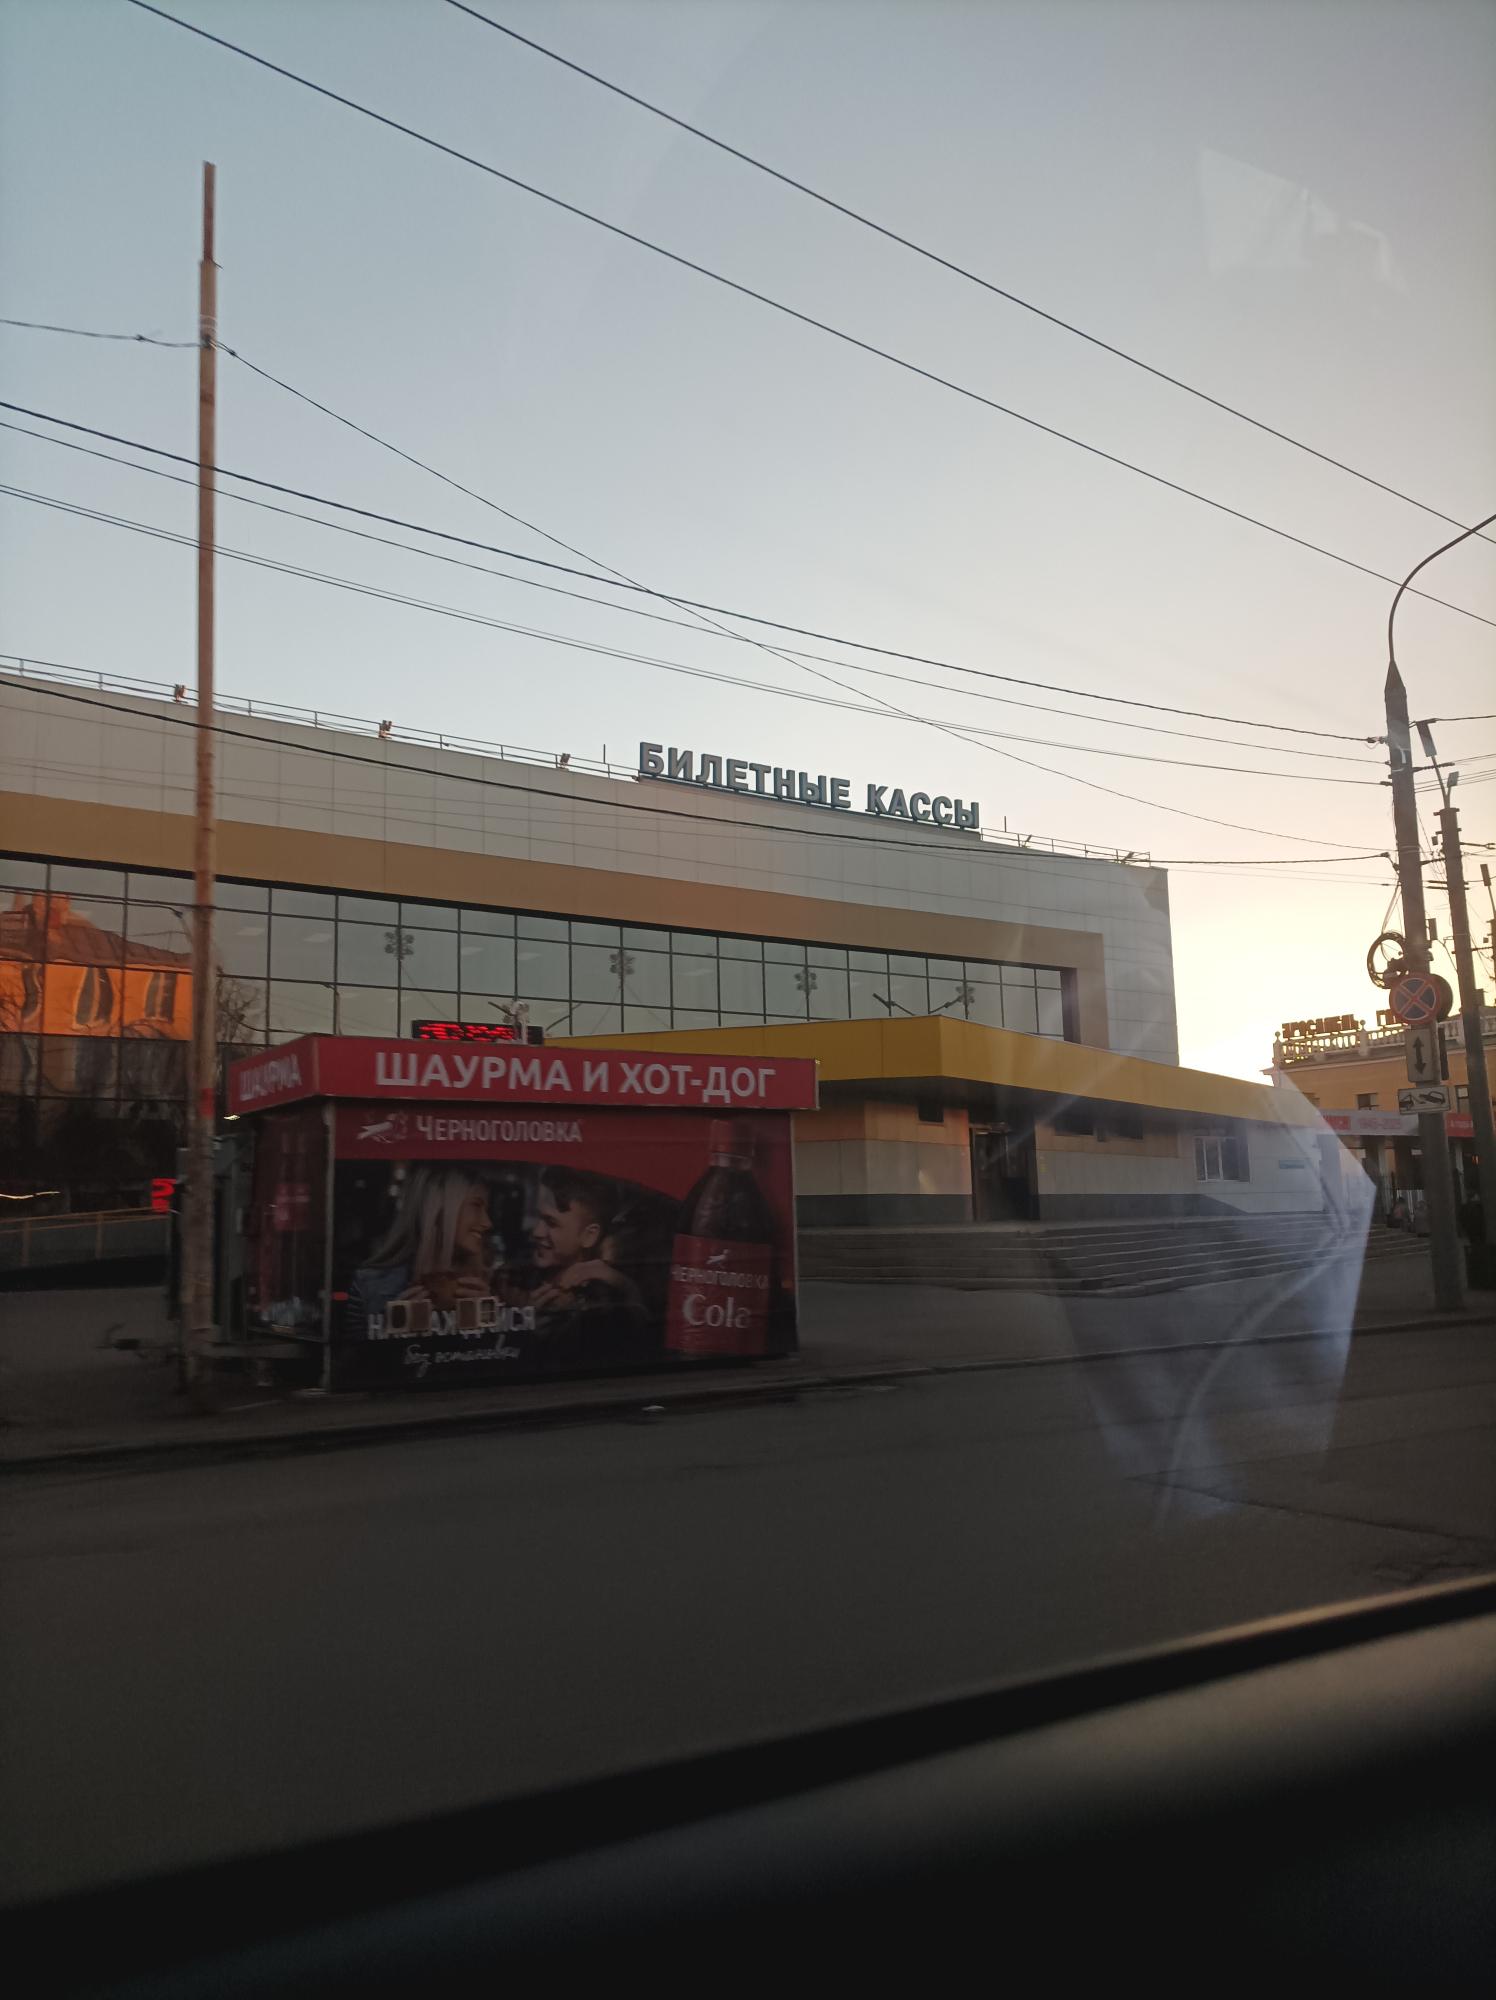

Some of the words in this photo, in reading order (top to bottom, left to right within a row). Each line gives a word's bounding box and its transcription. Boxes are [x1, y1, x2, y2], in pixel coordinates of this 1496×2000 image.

[639, 741, 851, 808] БИЛЕТНЫЕ
[865, 783, 980, 829] КАССЫ
[375, 1051, 571, 1092] ШАУРМА
[583, 1060, 609, 1093] И
[618, 1062, 777, 1104] ХОТ-ДОГ
[415, 1115, 583, 1143] ЧЕРНОГОЛОВКА
[682, 1293, 752, 1328] Cola
